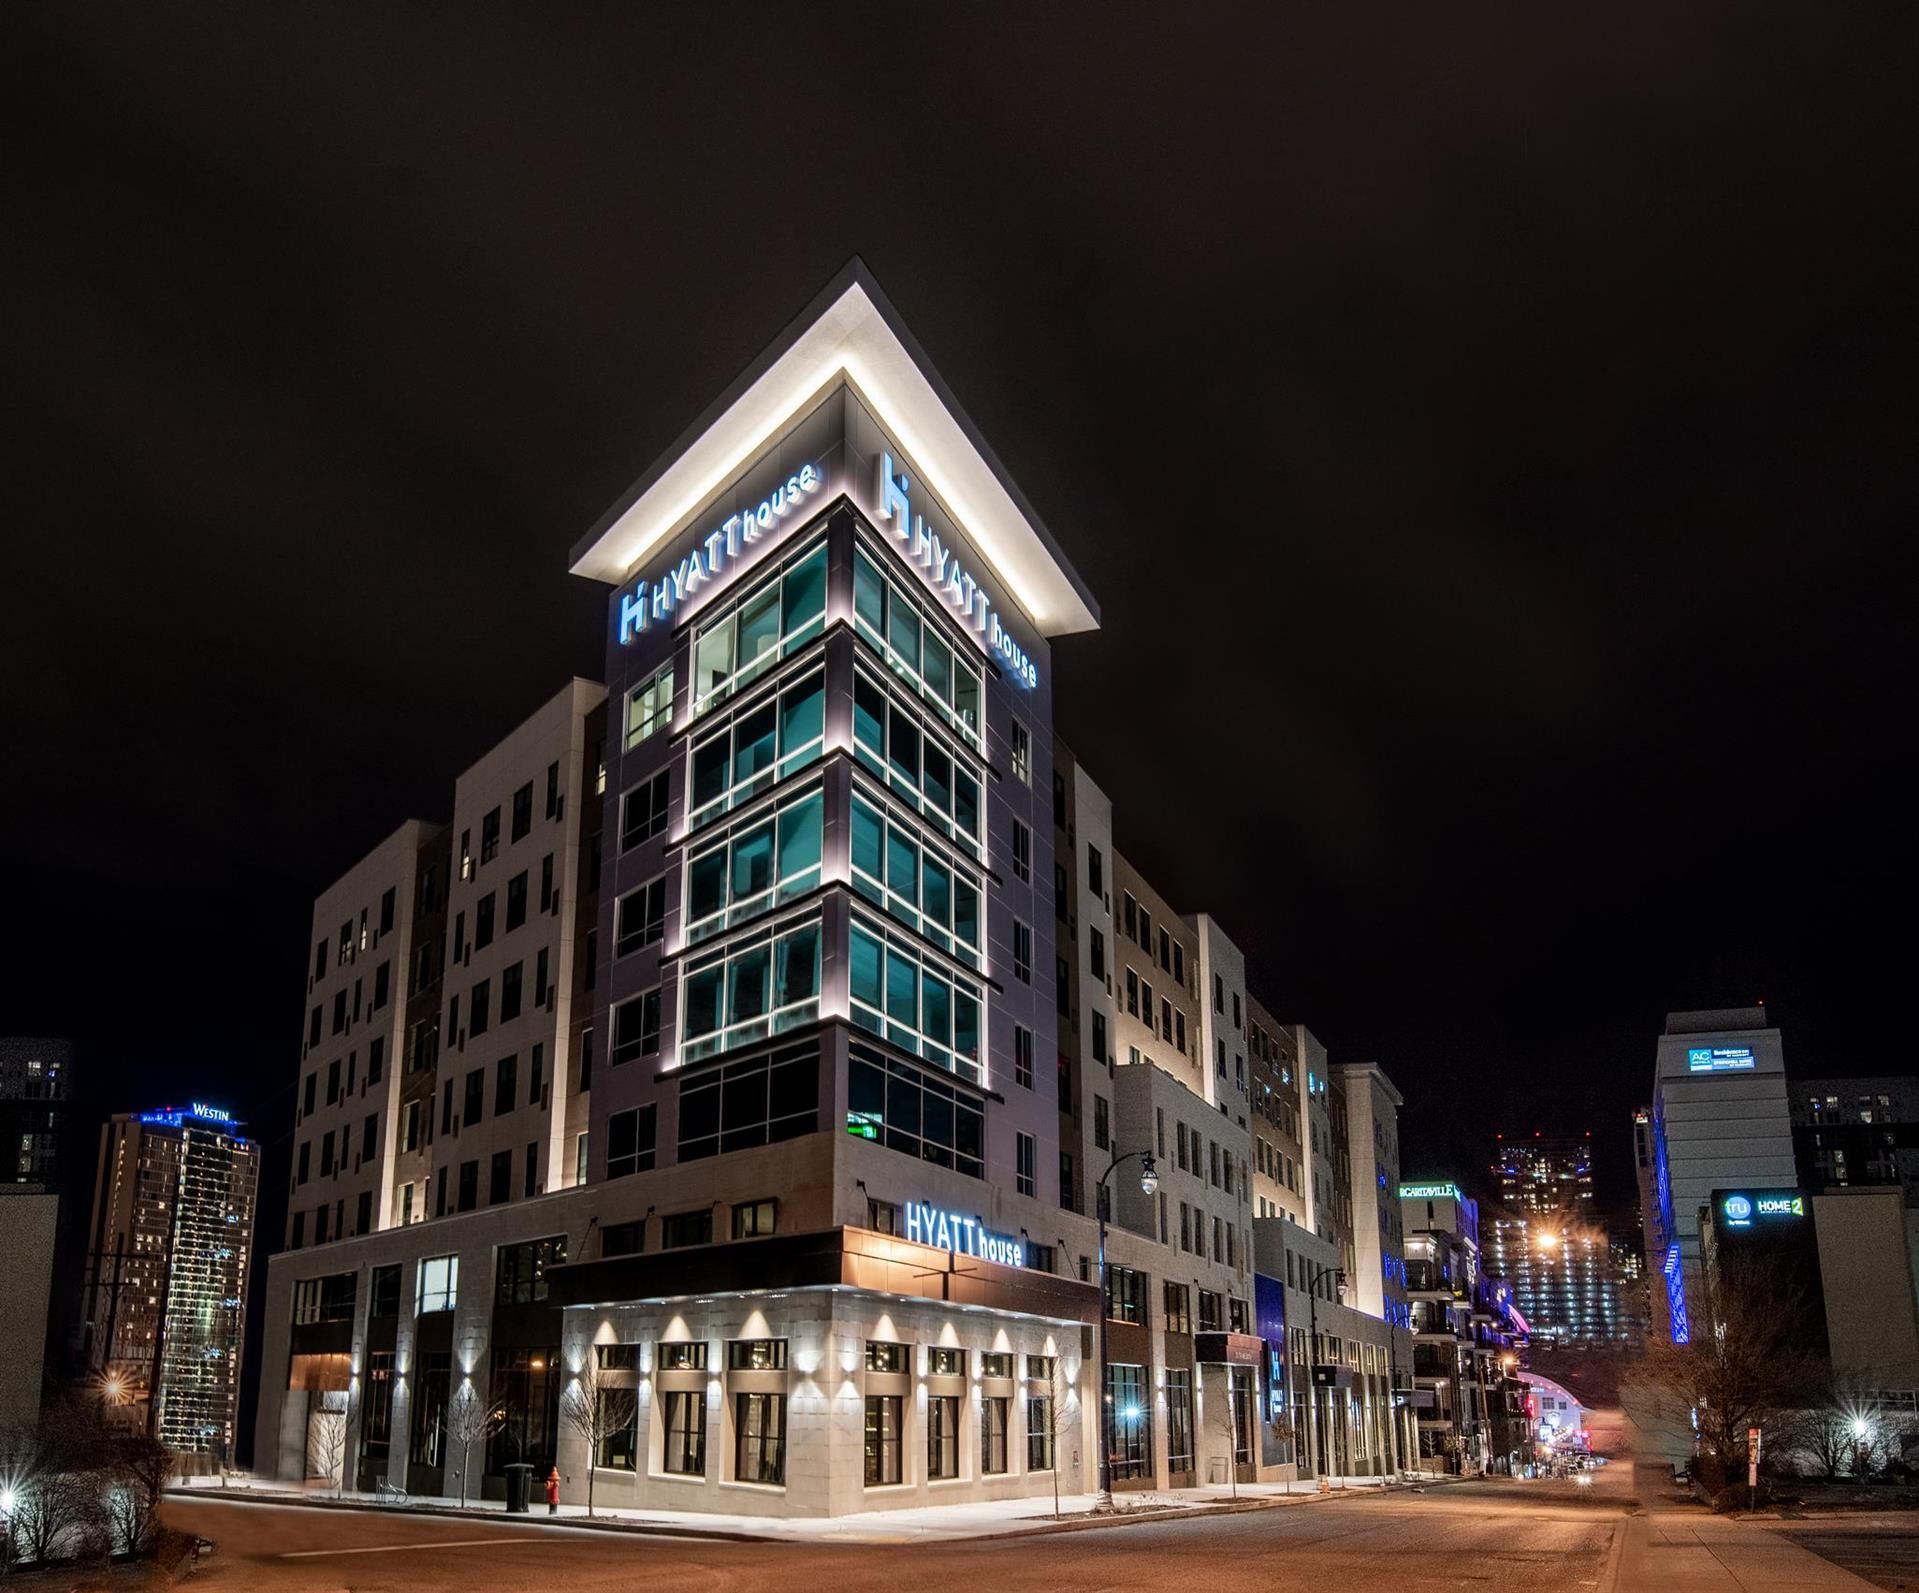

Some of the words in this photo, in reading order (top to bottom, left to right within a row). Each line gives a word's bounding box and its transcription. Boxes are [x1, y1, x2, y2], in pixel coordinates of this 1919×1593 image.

[650, 514, 742, 620] HYATT
[742, 463, 820, 543] house
[912, 514, 991, 632] HYATT
[991, 612, 1039, 689] house
[1692, 1051, 1709, 1060] AC
[1724, 1200, 1748, 1213] tru
[1758, 1200, 1791, 1211] HOME
[906, 1202, 975, 1257] HYATT
[978, 1228, 1022, 1267] house
